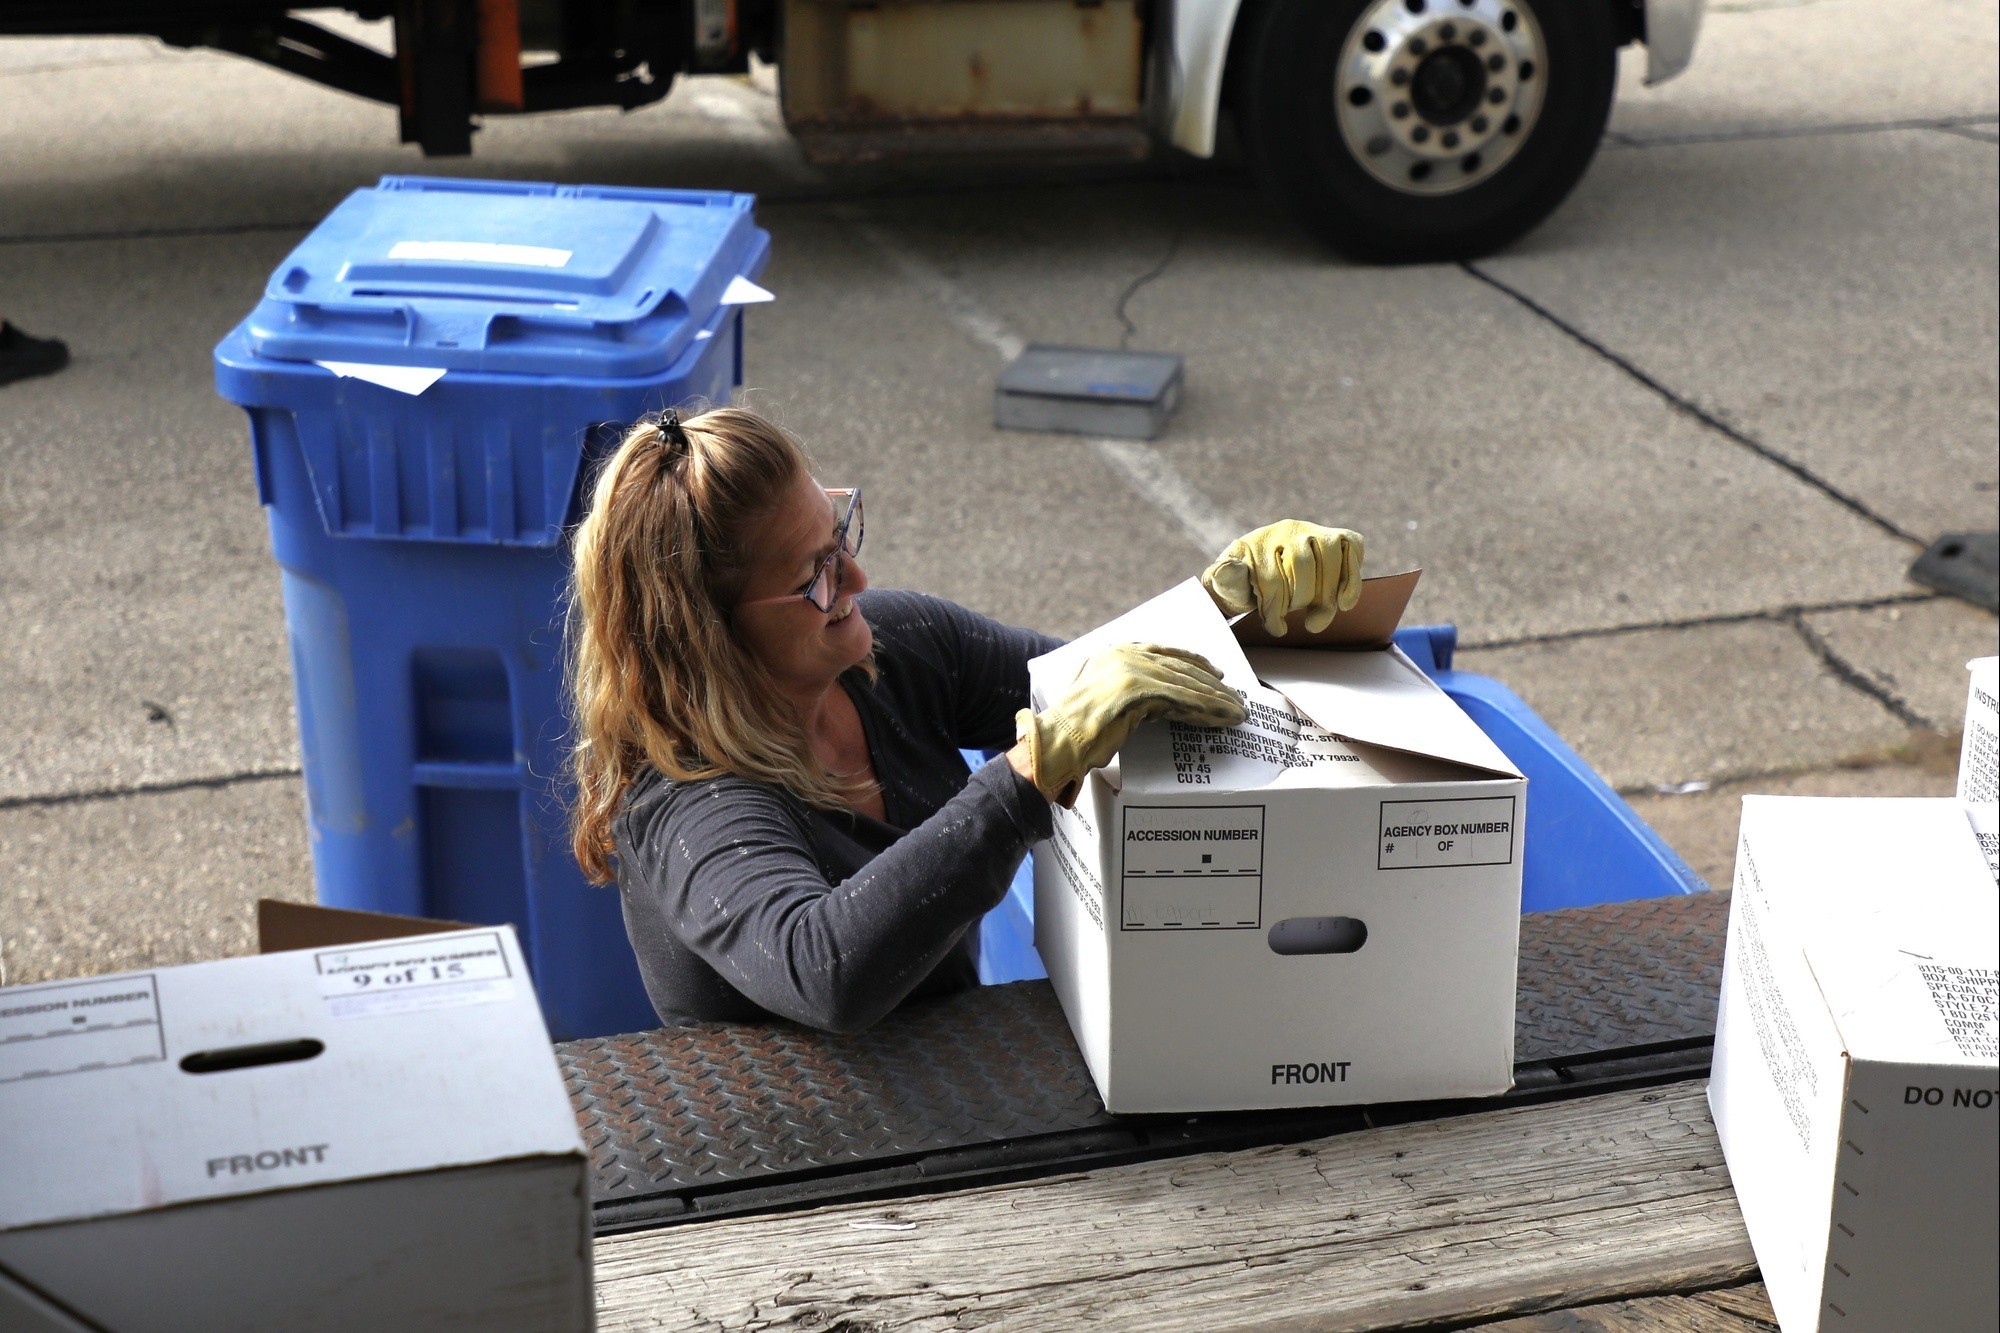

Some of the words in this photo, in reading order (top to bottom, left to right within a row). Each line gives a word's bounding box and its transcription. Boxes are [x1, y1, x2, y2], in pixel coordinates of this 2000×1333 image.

[1227, 728, 1283, 749] INDUSTRIES
[1263, 721, 1319, 743] DOMESTIC,
[1170, 732, 1201, 744] 11460
[1204, 734, 1262, 752] PELLICANO
[1265, 746, 1276, 756] EL
[1310, 754, 1326, 762] TX
[1328, 754, 1360, 763] 79936
[1173, 741, 1206, 754] CONT.
[1174, 752, 1195, 763] P.O.
[1199, 754, 1206, 763] #
[1175, 762, 1194, 773] WT
[1196, 763, 1211, 774] 45
[1177, 773, 1193, 784] CU
[1195, 773, 1211, 785] 3.1
[1126, 830, 1201, 842] ACCESSION
[1203, 829, 1259, 841] NUMBER
[1383, 825, 1432, 838] AGENCY
[1434, 824, 1459, 836] BOX
[1460, 822, 1510, 834] NUMBER
[1385, 843, 1395, 853] #
[1437, 841, 1454, 852] OF
[353, 973, 372, 987] 9
[384, 967, 418, 985] of
[430, 962, 466, 980] 15
[1926, 982, 1982, 995] SPECIAL
[0, 1002, 68, 1018] ESSION
[72, 990, 150, 1008] NUMBER
[1934, 999, 1980, 1012] STYLE
[1944, 1018, 1985, 1029] COMM
[1271, 1062, 1352, 1085] FRONT
[1903, 1086, 1944, 1106] DO
[205, 1142, 330, 1179] FRONT
